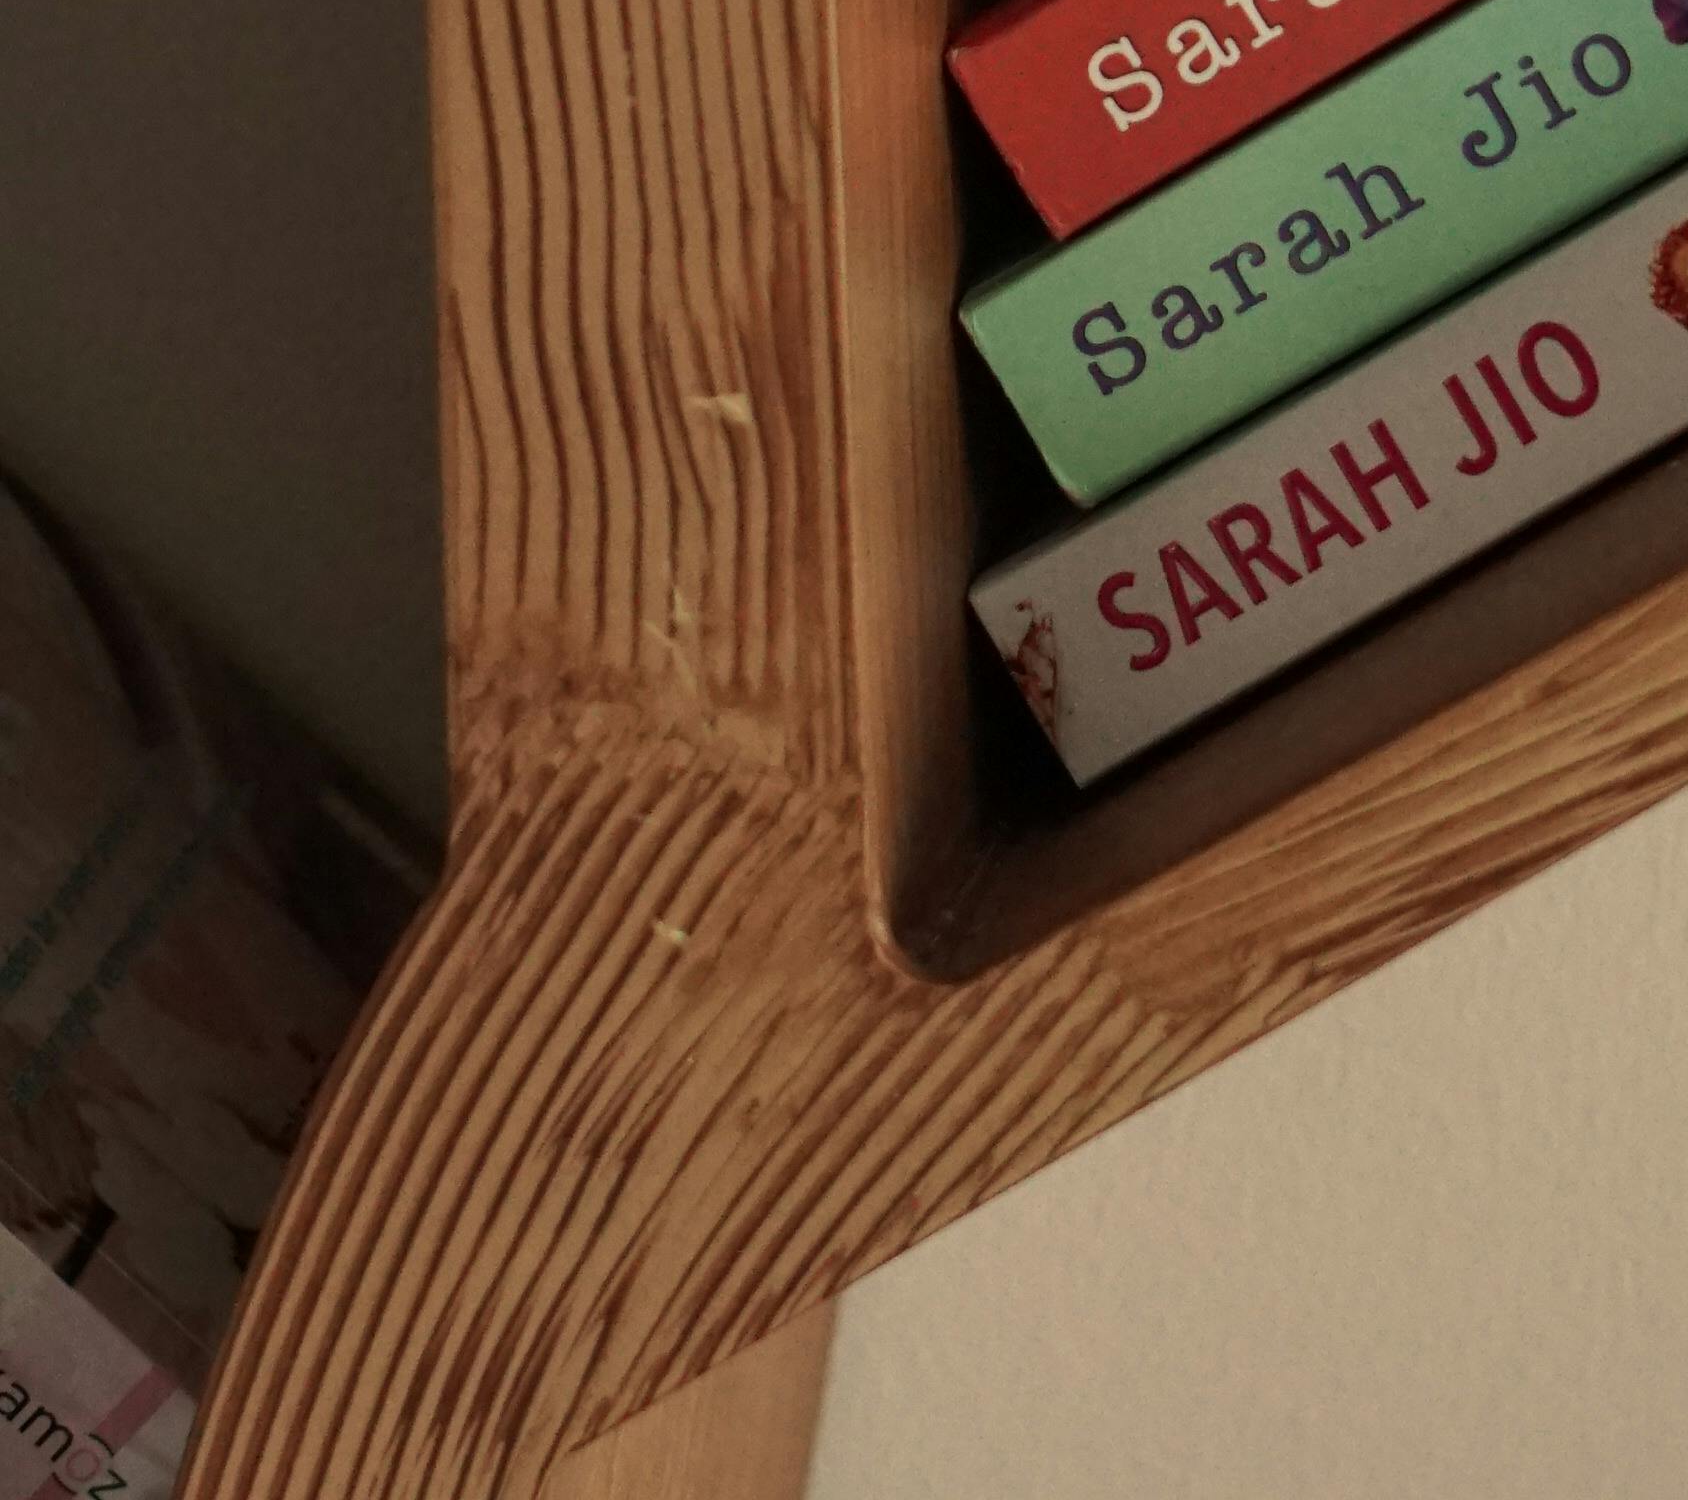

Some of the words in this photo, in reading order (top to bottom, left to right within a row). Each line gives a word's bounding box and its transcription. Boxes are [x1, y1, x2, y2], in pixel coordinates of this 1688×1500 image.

[1070, 152, 1425, 398] Sarah
[1460, 31, 1634, 171] Jio
[1093, 417, 1431, 673] SARAH
[1442, 320, 1602, 477] JIO
